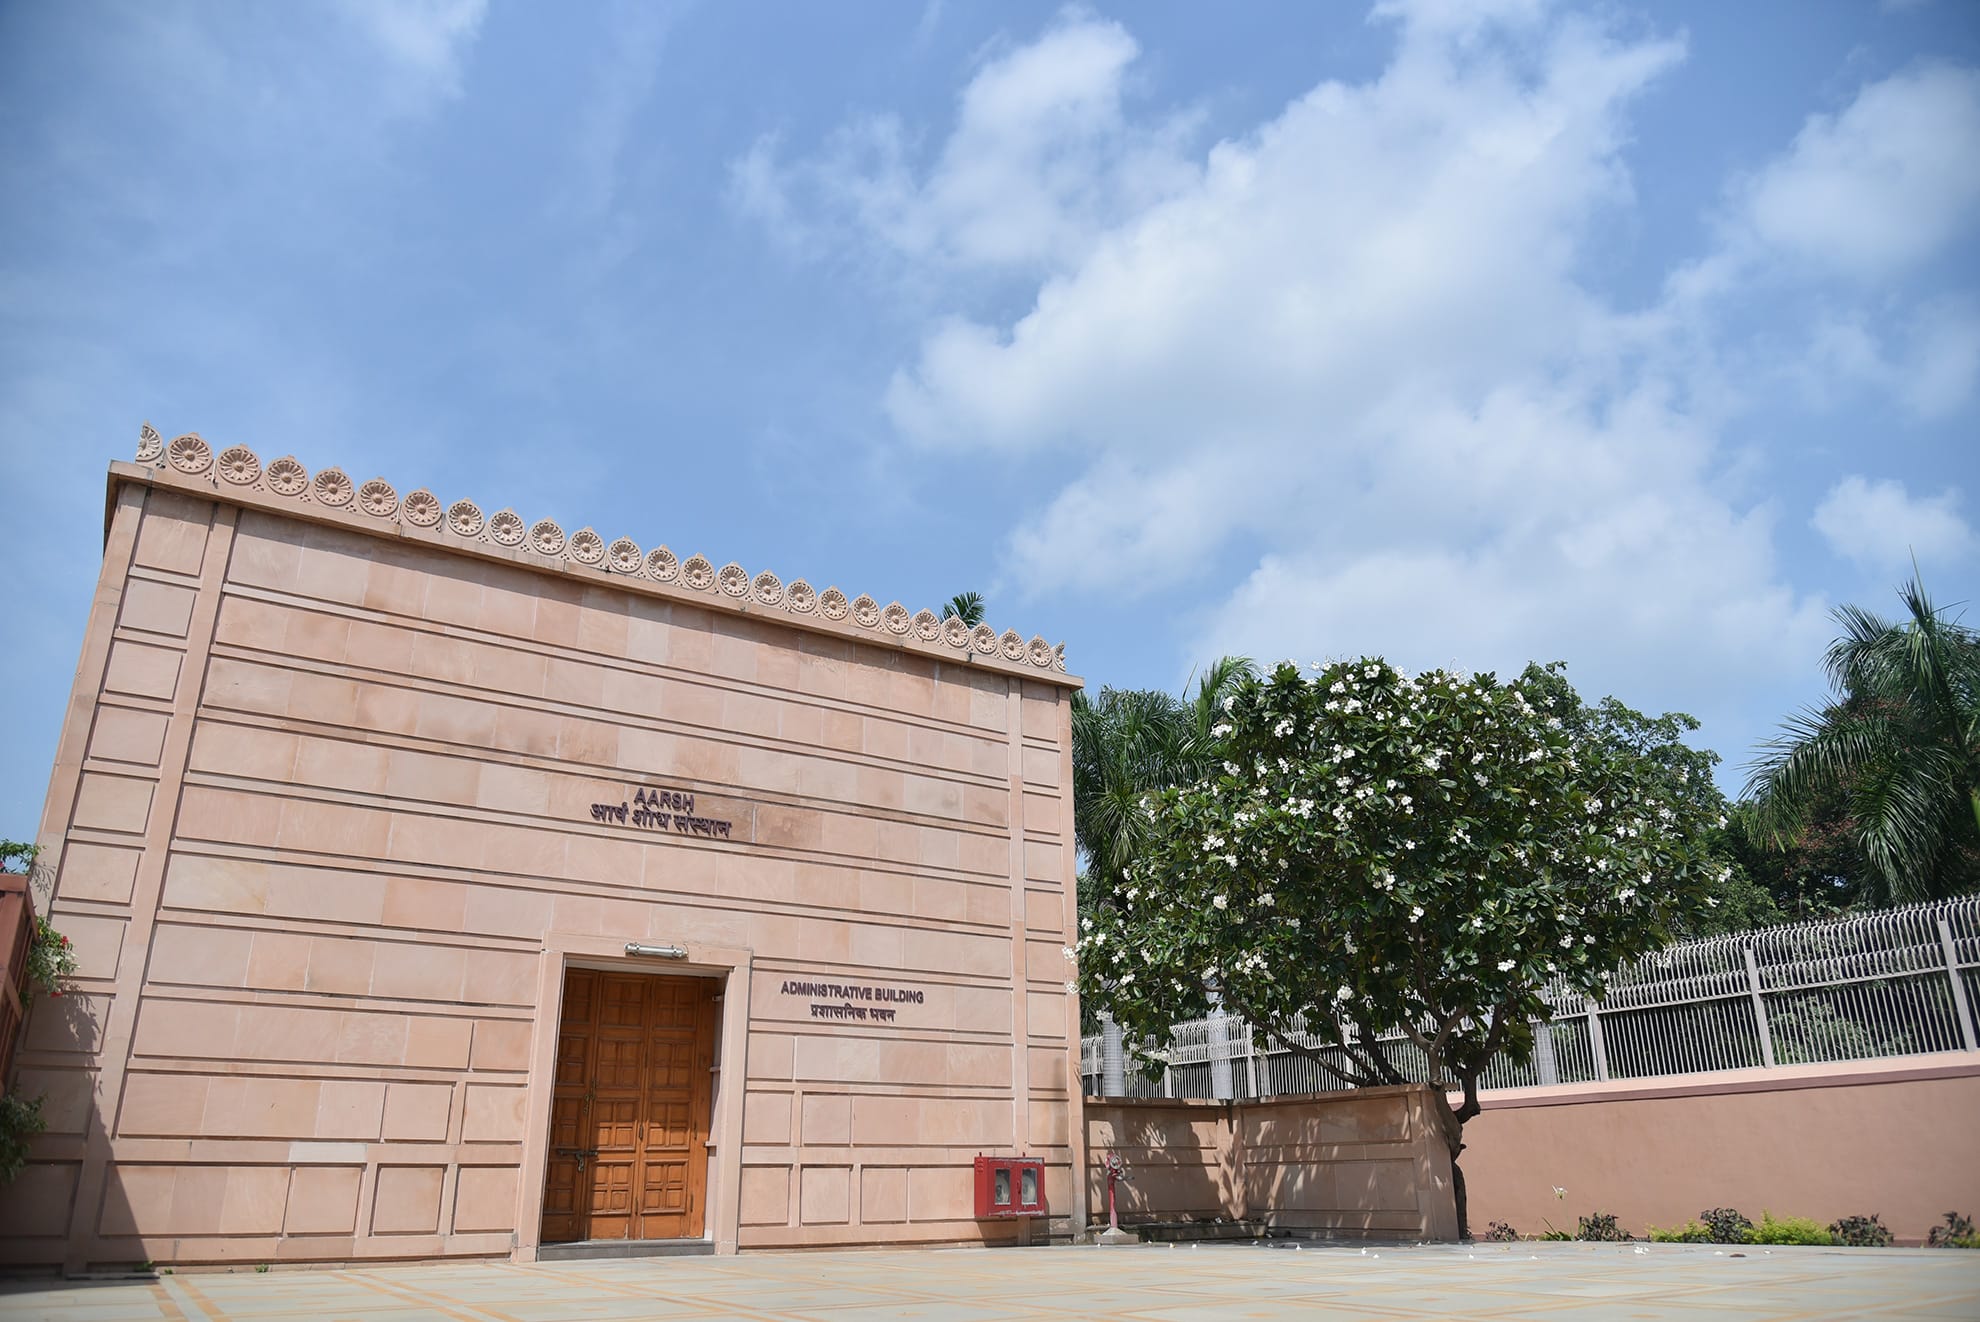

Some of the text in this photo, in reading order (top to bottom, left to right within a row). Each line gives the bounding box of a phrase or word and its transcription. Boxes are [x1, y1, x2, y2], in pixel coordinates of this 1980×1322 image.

[634, 787, 695, 813] AARSH
[590, 802, 732, 838] आर्ष शोध संस्थान
[781, 981, 924, 1004] ADMINISTRATIVE BUILDING
[811, 1002, 896, 1022] प्रशासनिक भवन
